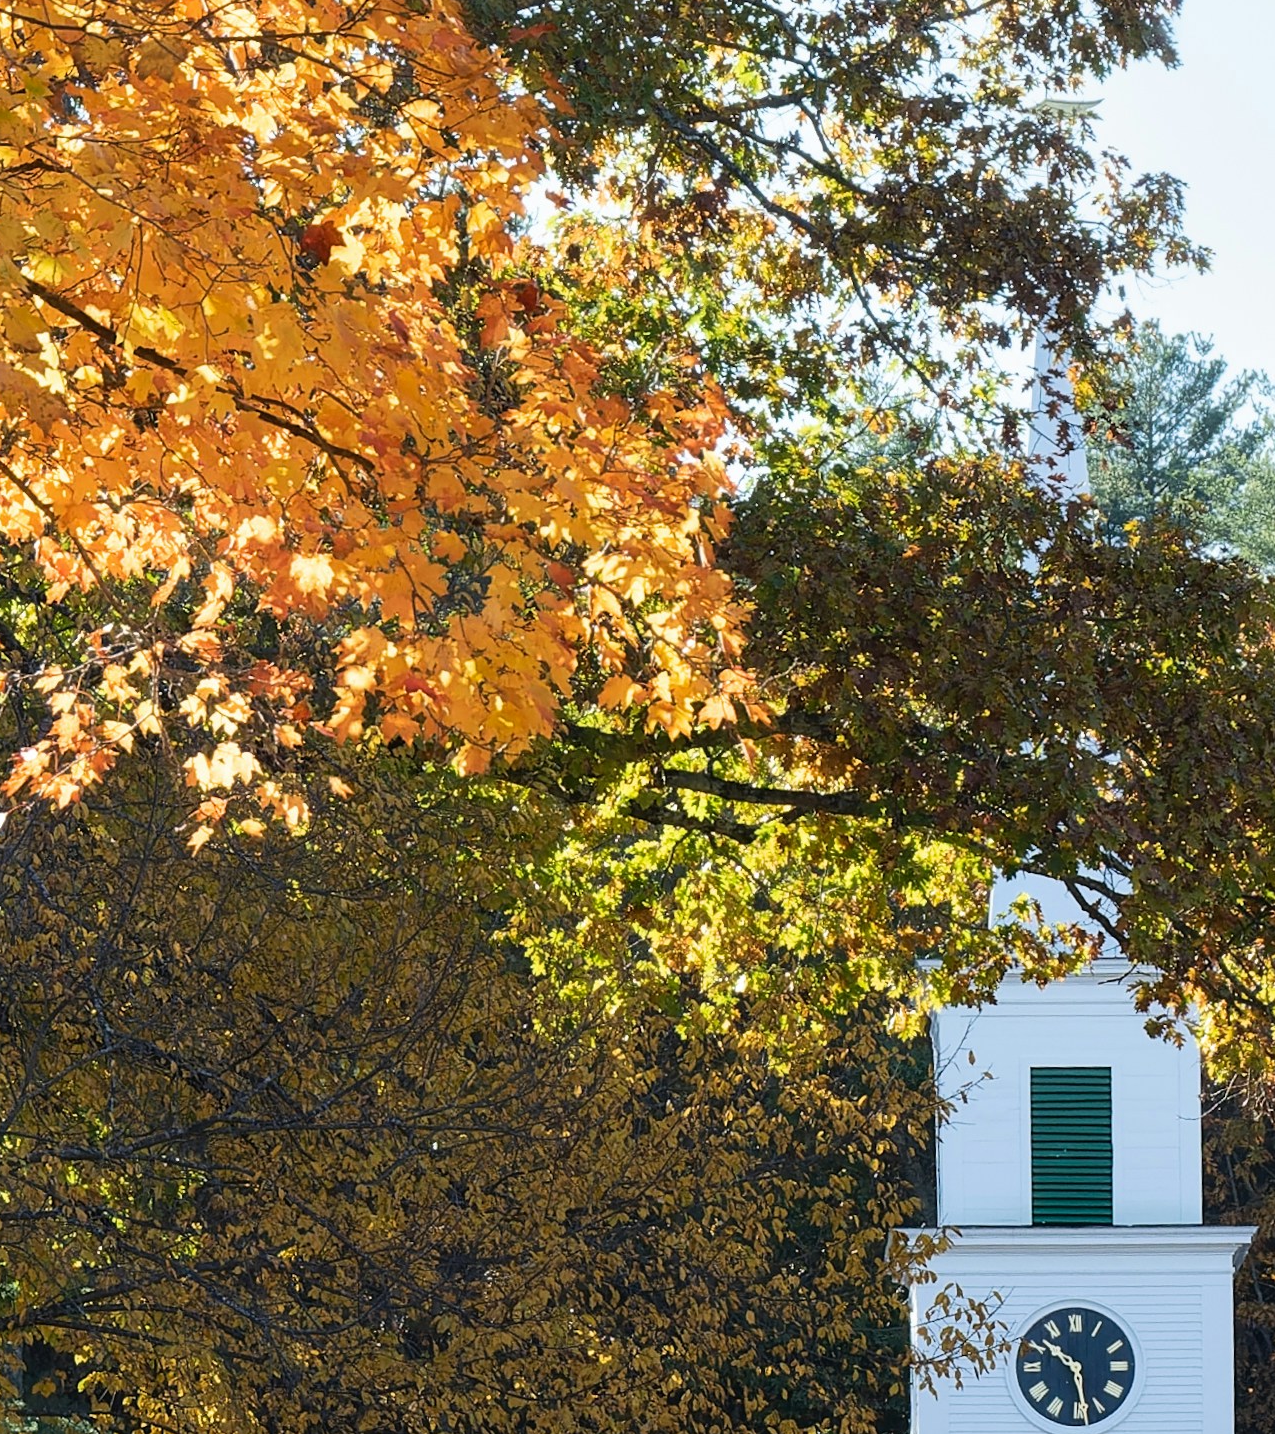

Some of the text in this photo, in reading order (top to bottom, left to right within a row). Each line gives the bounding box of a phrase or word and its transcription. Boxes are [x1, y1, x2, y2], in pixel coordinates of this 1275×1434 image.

[1044, 1320, 1061, 1339] XI
[1068, 1314, 1082, 1332] XII
[1091, 1321, 1102, 1337] I
[1106, 1340, 1123, 1354] II
[1023, 1361, 1041, 1372] IX
[1110, 1361, 1128, 1371] III
[1046, 1396, 1063, 1417] VII
[1092, 1397, 1105, 1413] V
